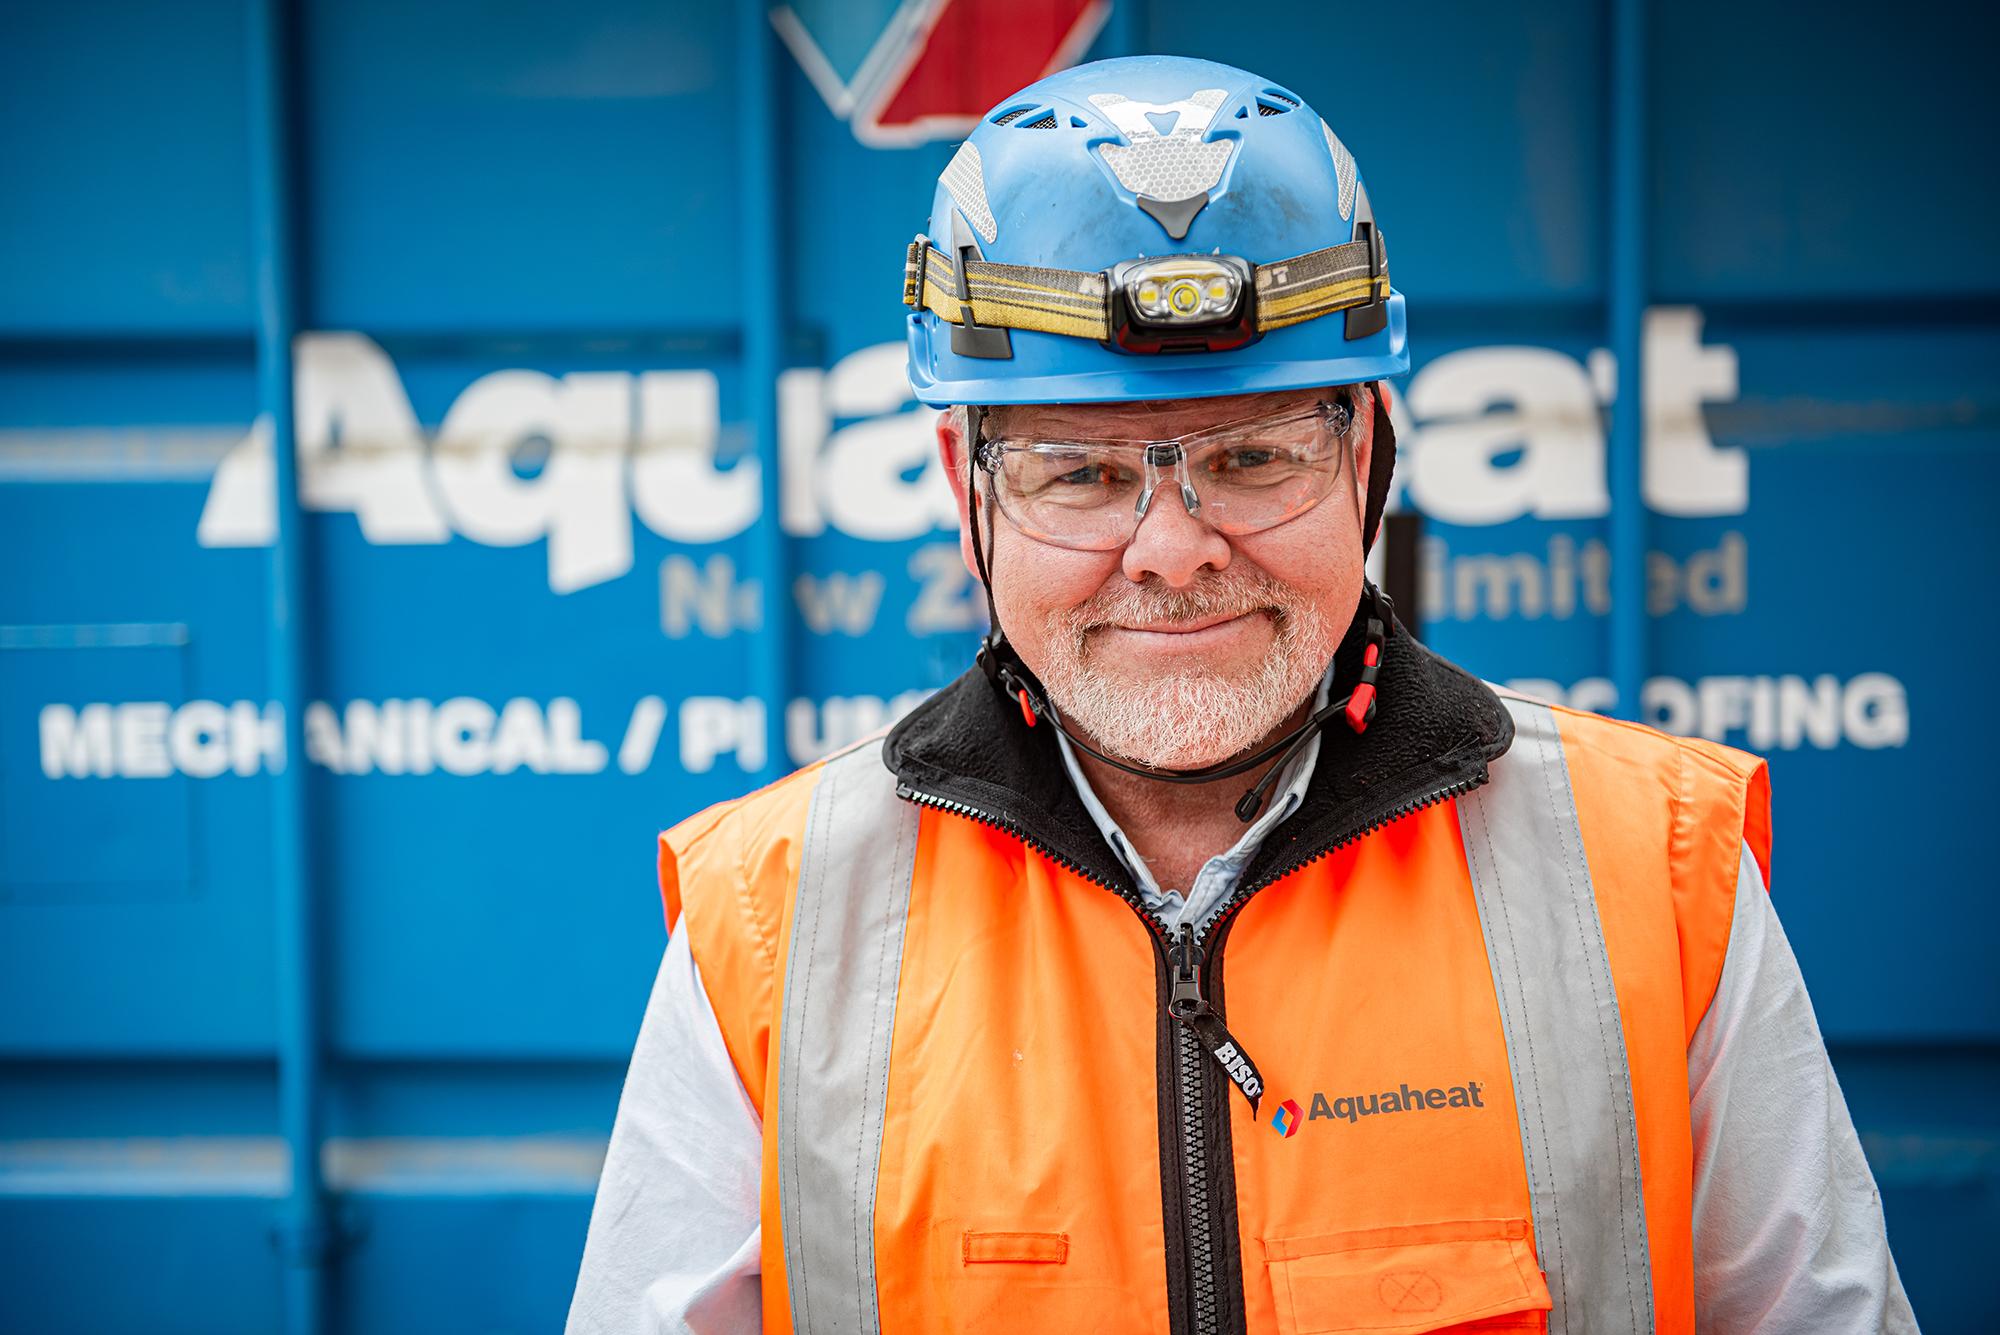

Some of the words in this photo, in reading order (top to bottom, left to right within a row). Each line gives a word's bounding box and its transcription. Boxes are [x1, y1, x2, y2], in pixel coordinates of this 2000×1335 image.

[198, 306, 1748, 592] Aquaat
[39, 697, 606, 779] MECHANICAL
[1214, 1041, 1261, 1096] BISO
[1308, 1081, 1484, 1123] Aquaheat
